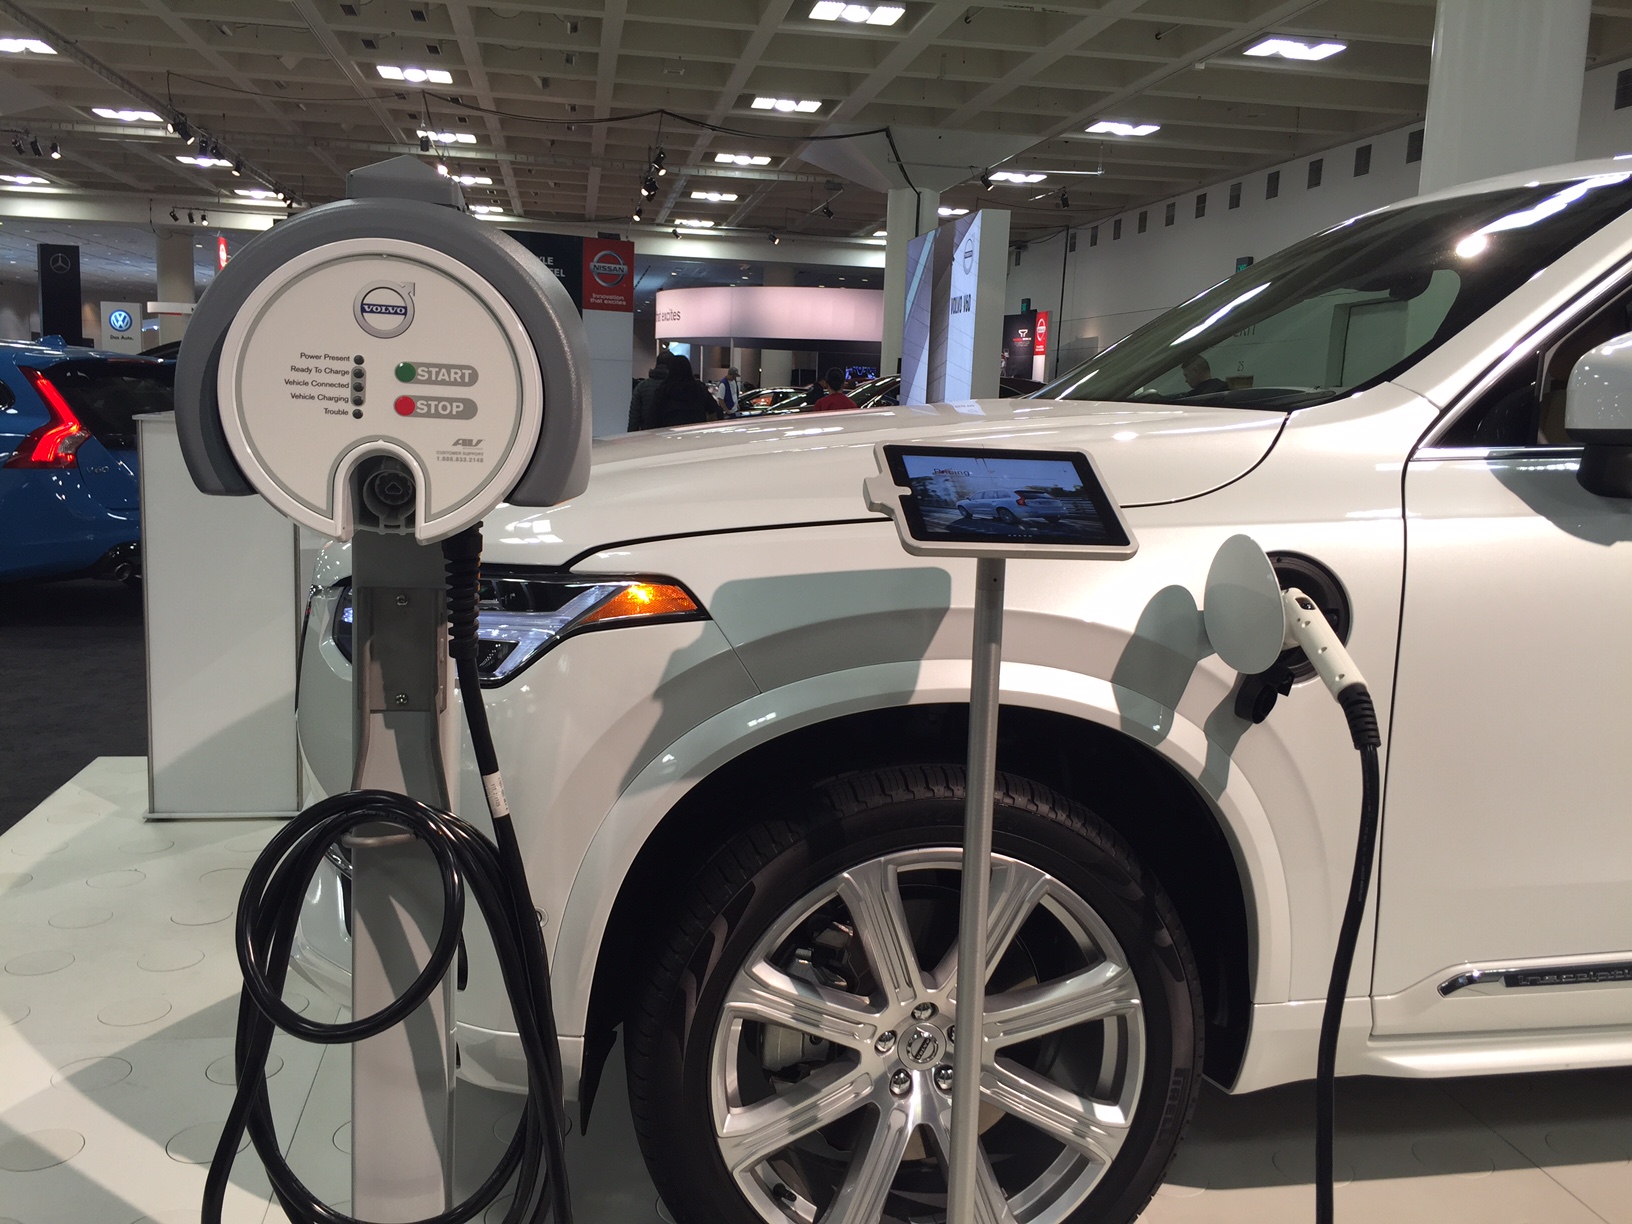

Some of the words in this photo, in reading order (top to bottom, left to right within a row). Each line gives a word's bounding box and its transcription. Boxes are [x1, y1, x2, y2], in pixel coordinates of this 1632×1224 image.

[593, 264, 625, 274] NISSAN
[592, 293, 625, 301] Innovation
[363, 304, 406, 315] VOLVO
[950, 295, 963, 315] VOLVO
[300, 352, 322, 360] Power
[323, 353, 350, 362] Present
[290, 365, 313, 375] Ready
[314, 366, 323, 374] To
[323, 367, 350, 377] Charge
[416, 366, 472, 383] START
[284, 379, 309, 387] Vehicle
[310, 379, 350, 389] Connected
[290, 392, 316, 401] Vehicle
[317, 393, 350, 404] Charging
[323, 407, 349, 416] Trouble
[416, 399, 464, 415] STOP
